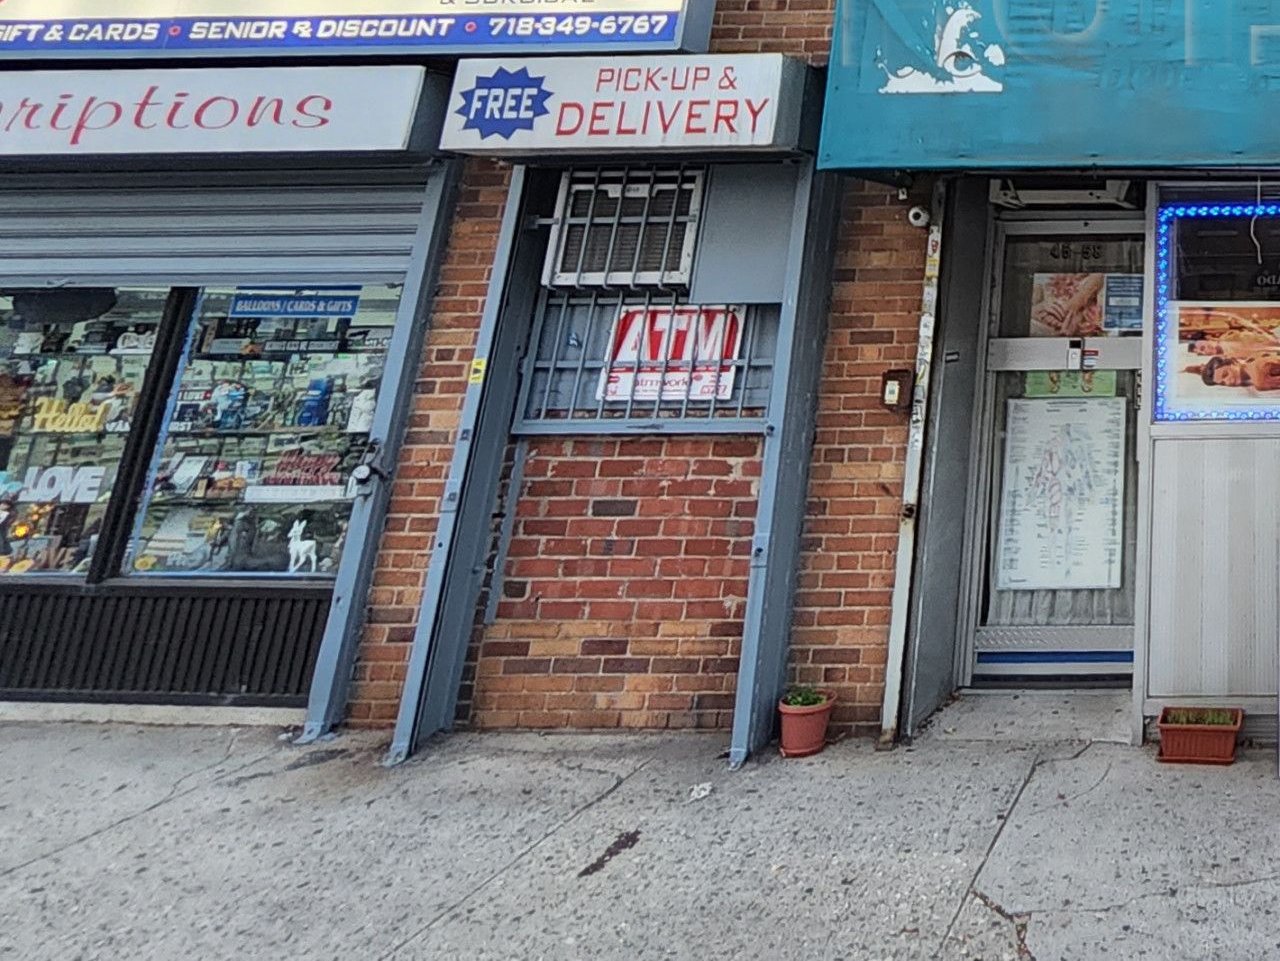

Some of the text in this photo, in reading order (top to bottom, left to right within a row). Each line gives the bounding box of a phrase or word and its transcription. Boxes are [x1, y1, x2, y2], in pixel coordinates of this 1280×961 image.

[44, 24, 64, 41] &
[68, 23, 161, 42] CARDS
[189, 21, 286, 40] SENIOR
[317, 18, 455, 39] DISCOUNT
[489, 14, 668, 37] 718-349-6767
[595, 65, 738, 93] PICK-UP &
[0, 86, 333, 145] riptions
[468, 87, 539, 120] FREE
[555, 97, 770, 137] DELIVERY
[326, 299, 354, 313] GIFTS
[614, 312, 733, 362] ATM
[18, 466, 106, 503] LOVE
